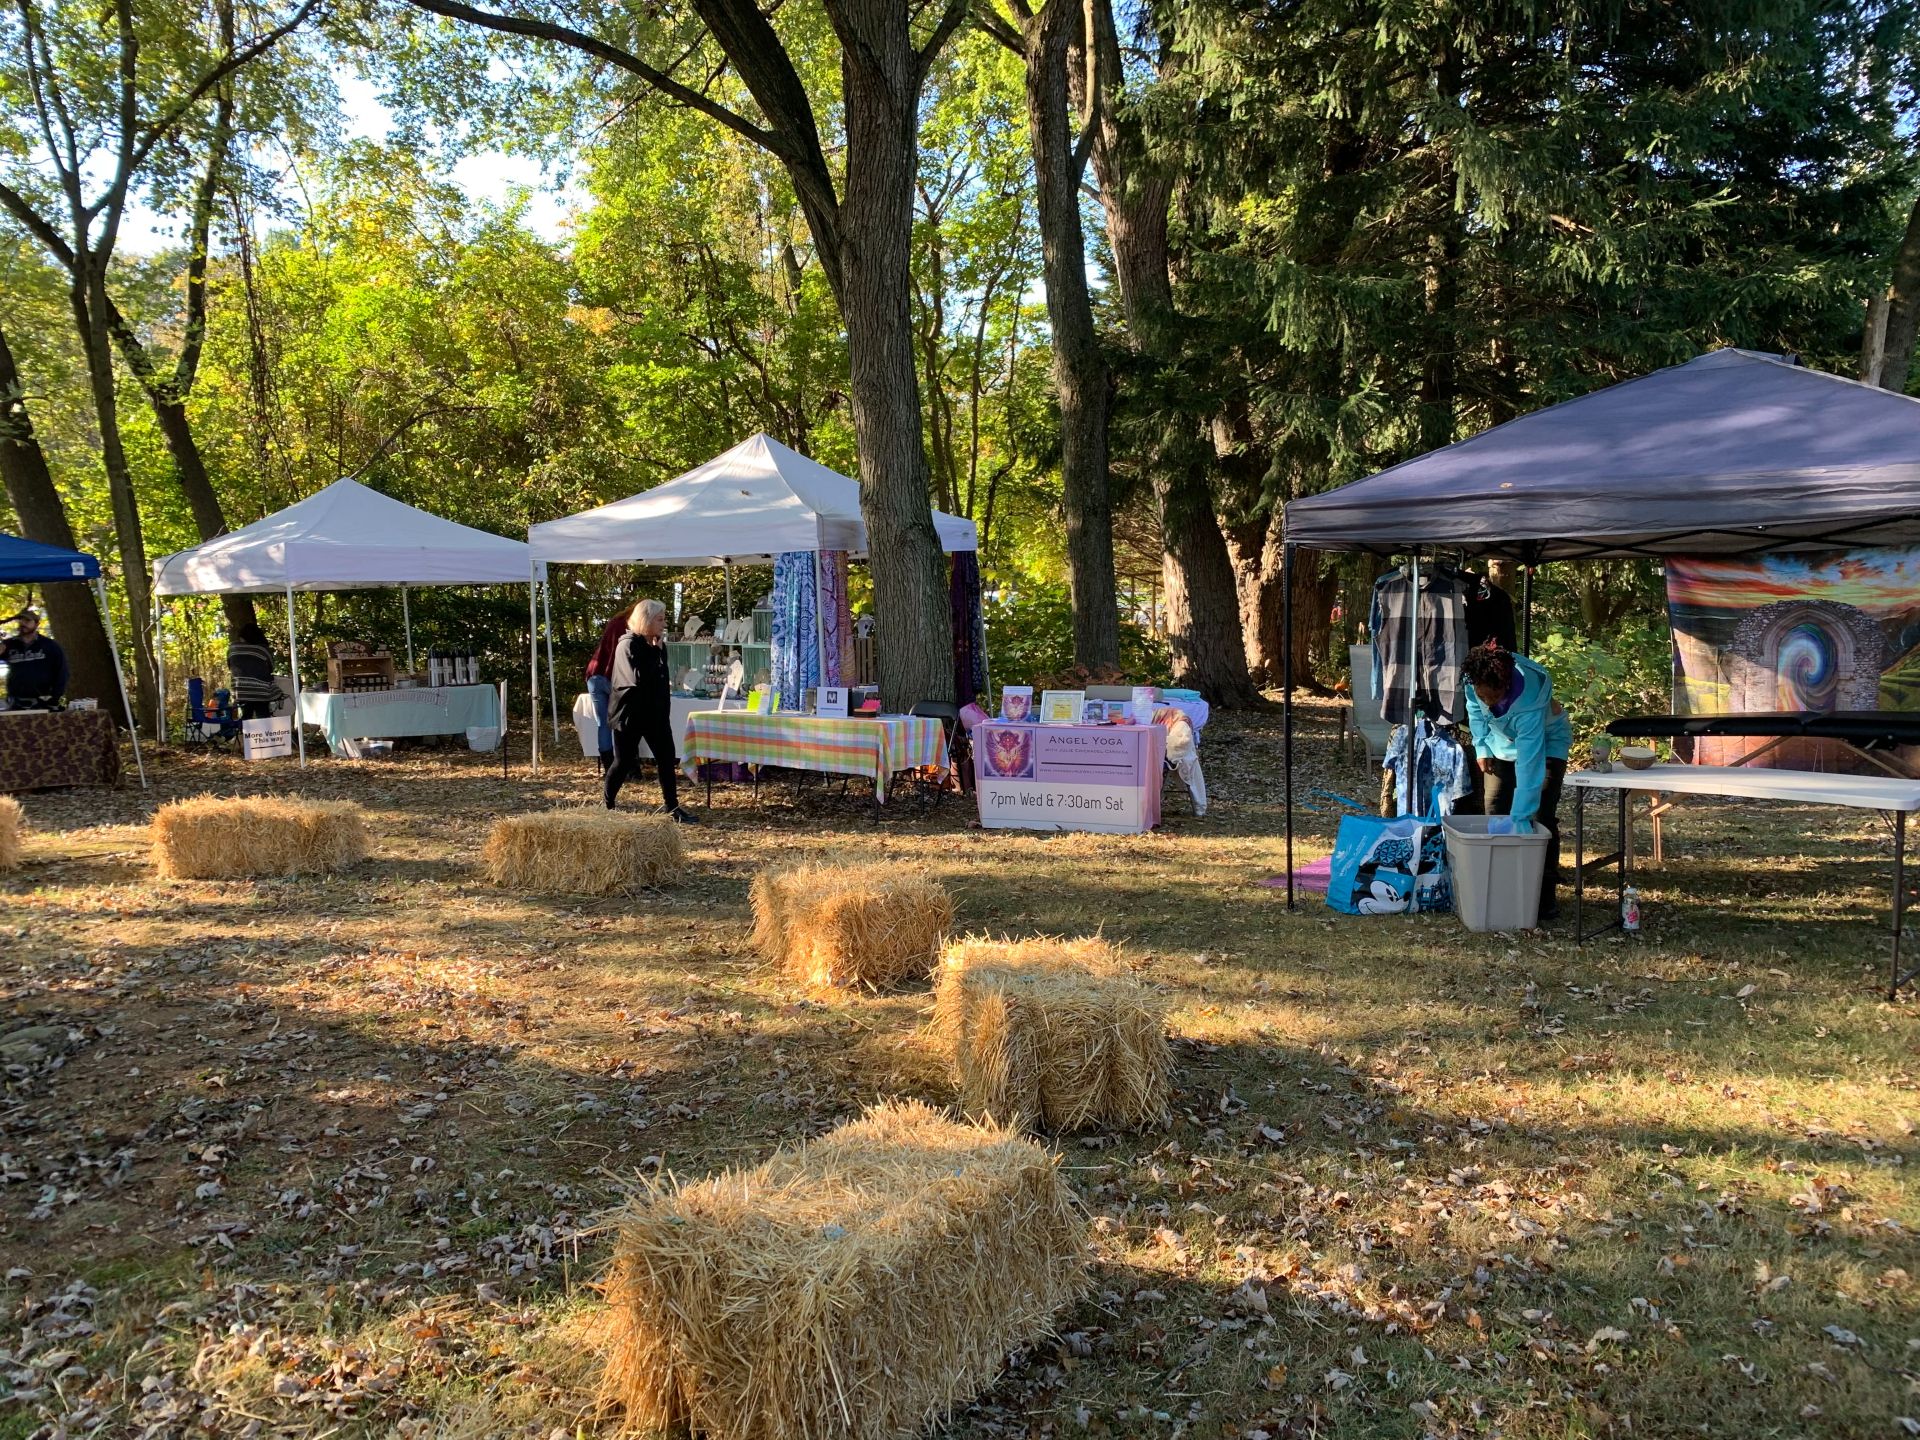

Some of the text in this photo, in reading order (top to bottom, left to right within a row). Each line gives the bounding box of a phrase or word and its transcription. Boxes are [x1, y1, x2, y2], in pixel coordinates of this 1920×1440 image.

[264, 729, 290, 737] Vendors
[1048, 735, 1123, 746] ANGEL YOGA
[990, 791, 1124, 811] 7pm Wed & 7:30am Sat
